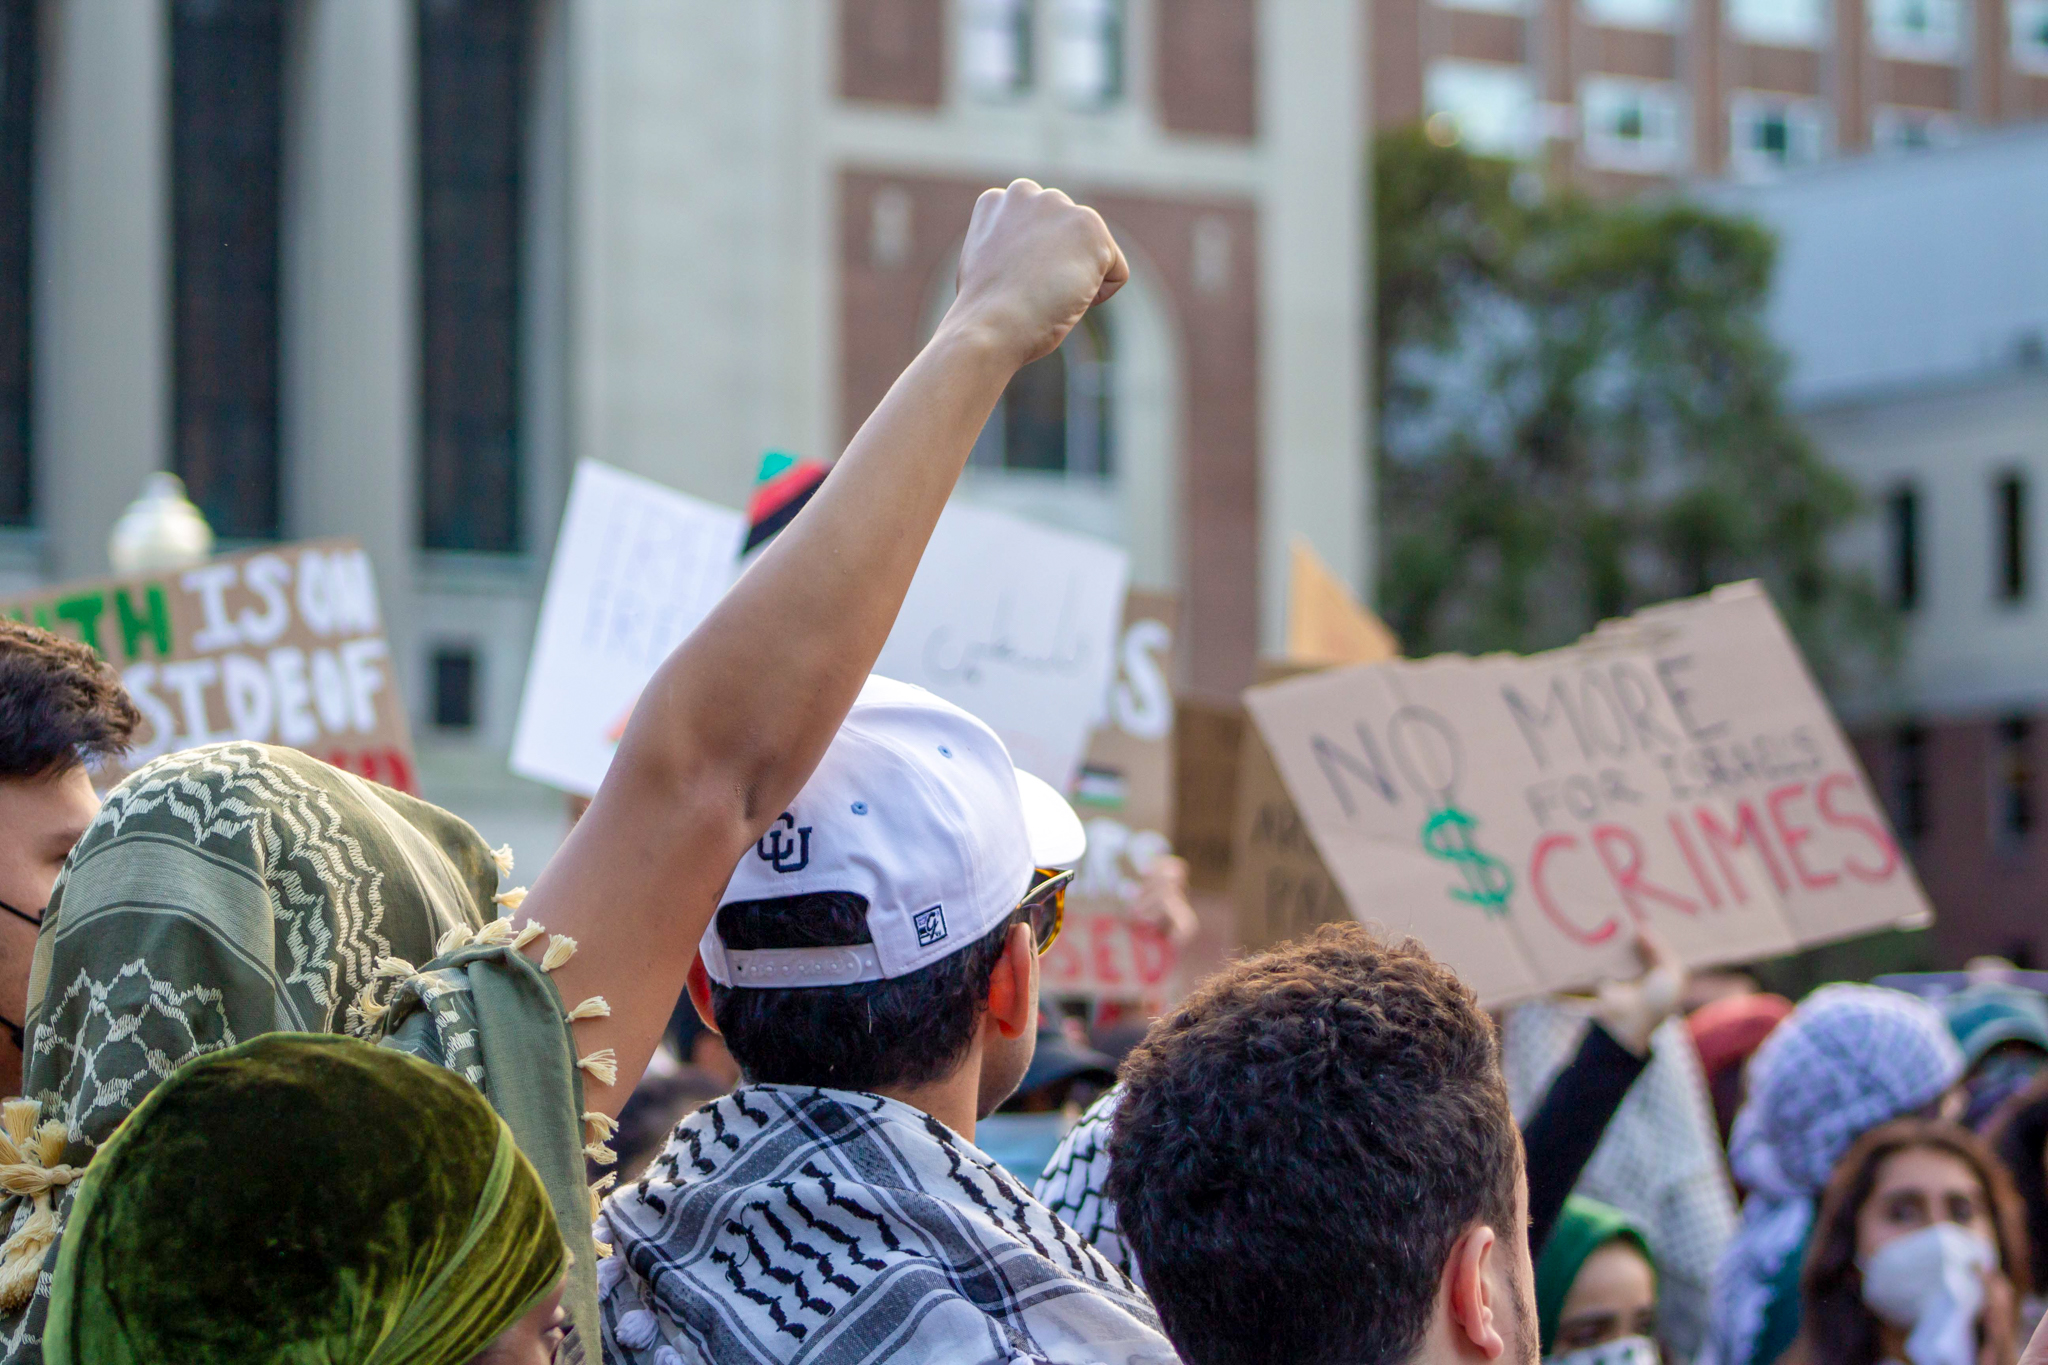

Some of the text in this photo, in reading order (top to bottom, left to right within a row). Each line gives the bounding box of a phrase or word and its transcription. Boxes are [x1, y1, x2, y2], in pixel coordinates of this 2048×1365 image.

[182, 552, 293, 651] IS
[312, 636, 387, 735] OF
[1309, 654, 1729, 818] NO MORE
[757, 812, 812, 873] CU
[1524, 766, 1645, 829] FOR
[1529, 771, 1900, 946] CRIMES
